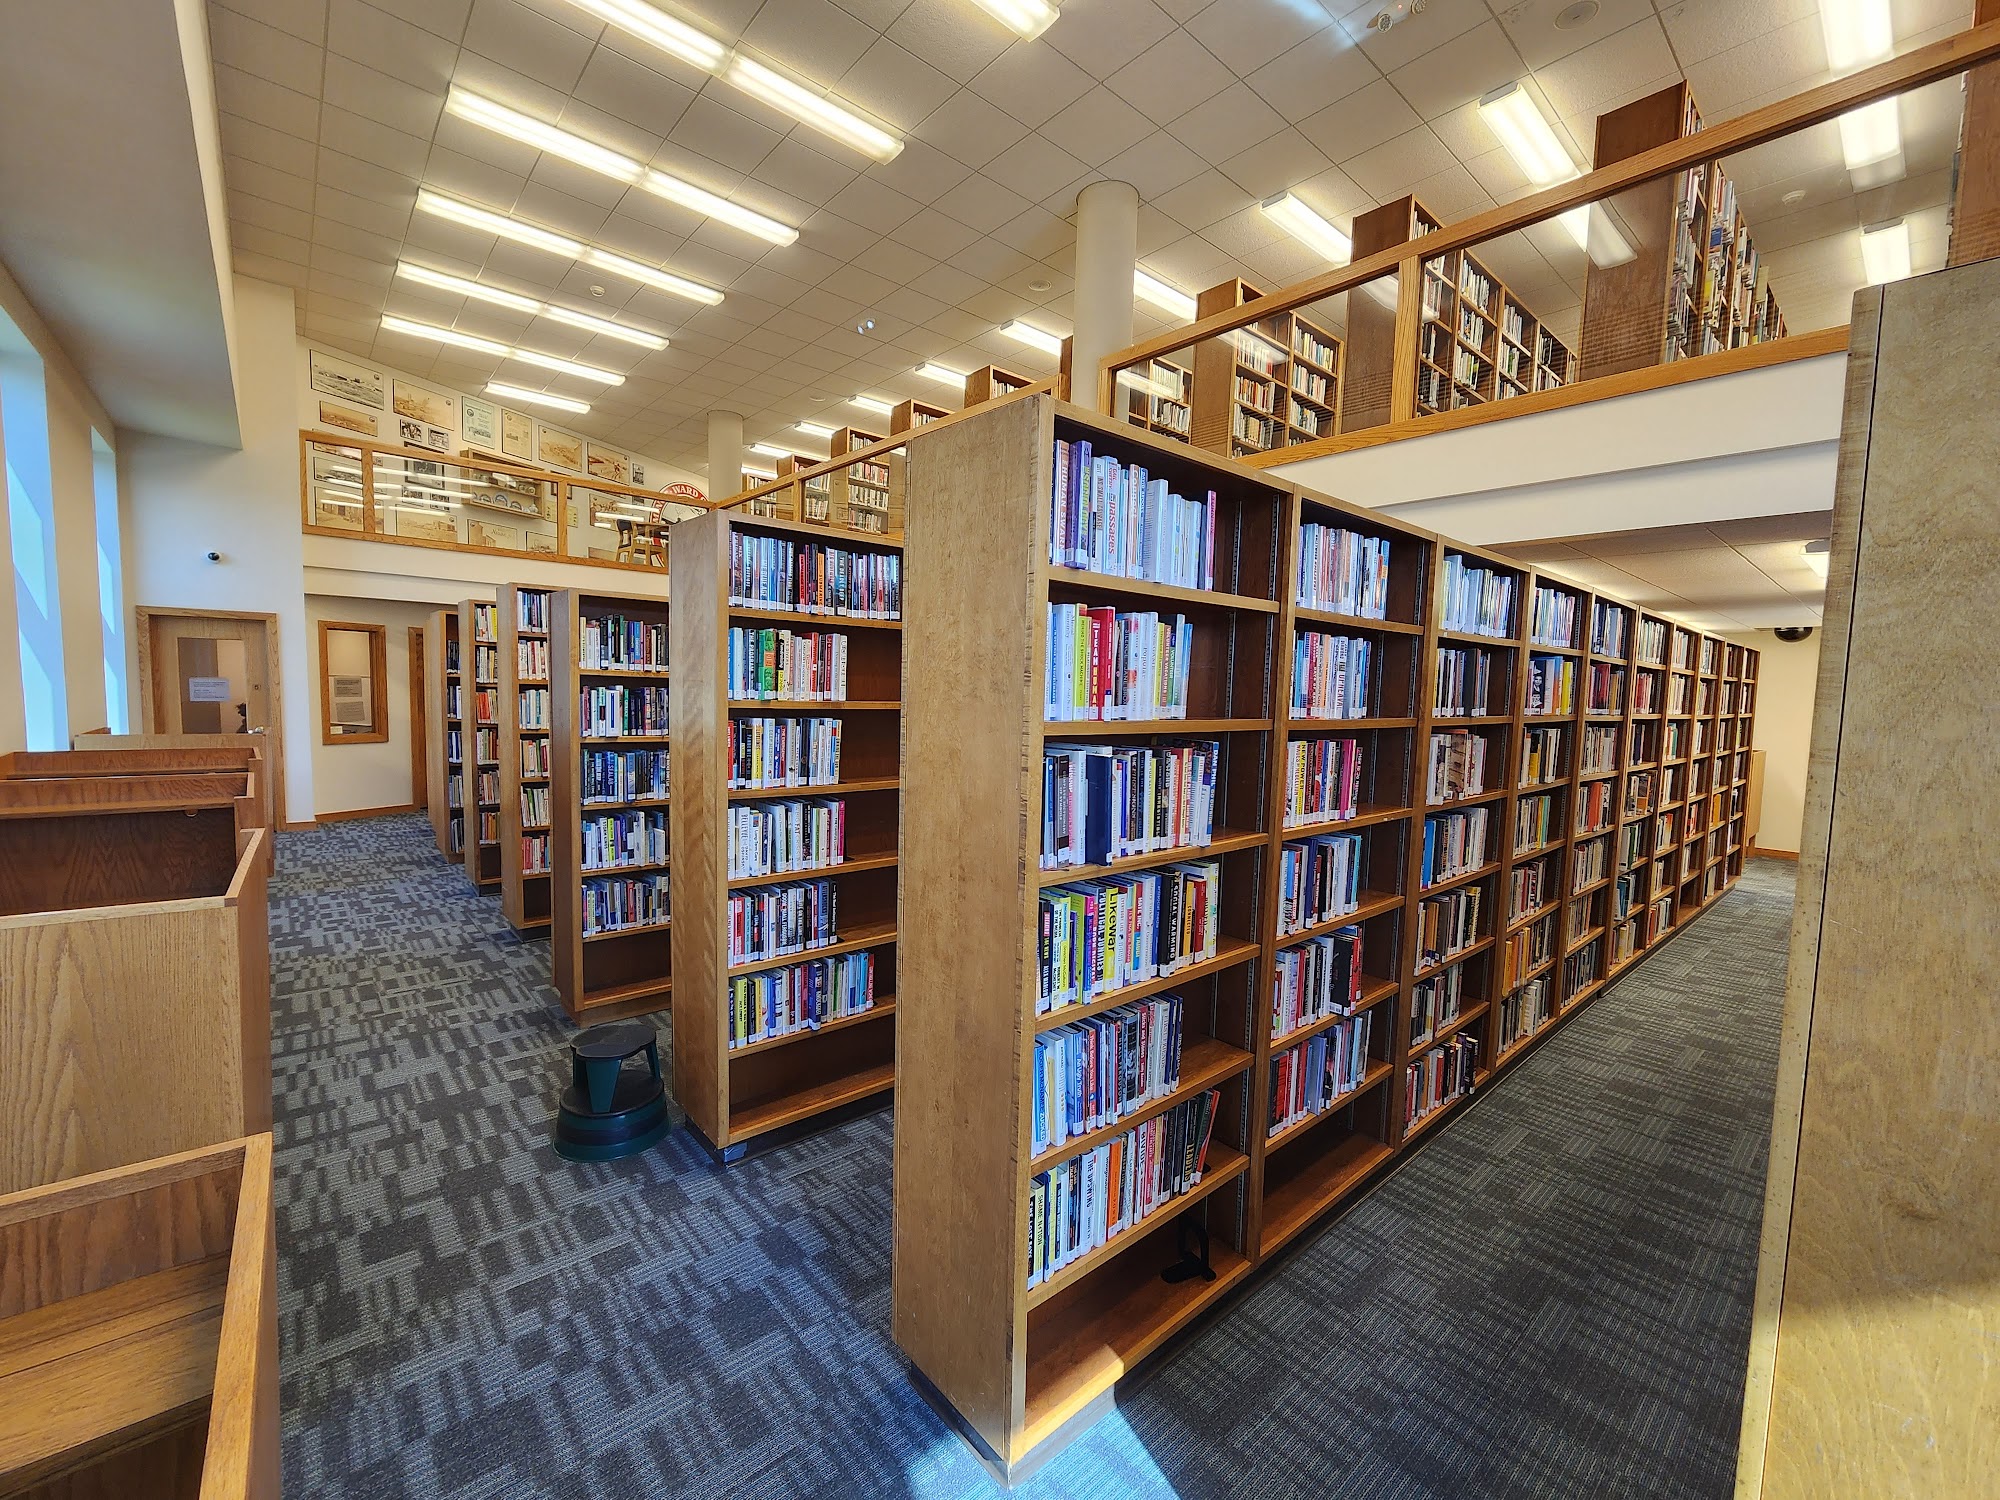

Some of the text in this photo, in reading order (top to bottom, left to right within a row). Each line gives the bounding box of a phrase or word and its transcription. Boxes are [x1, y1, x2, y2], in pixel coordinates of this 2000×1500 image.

[1108, 501, 1117, 554] passages
[1210, 768, 1218, 786] PHIL
[1098, 892, 1106, 935] POLITICAL
